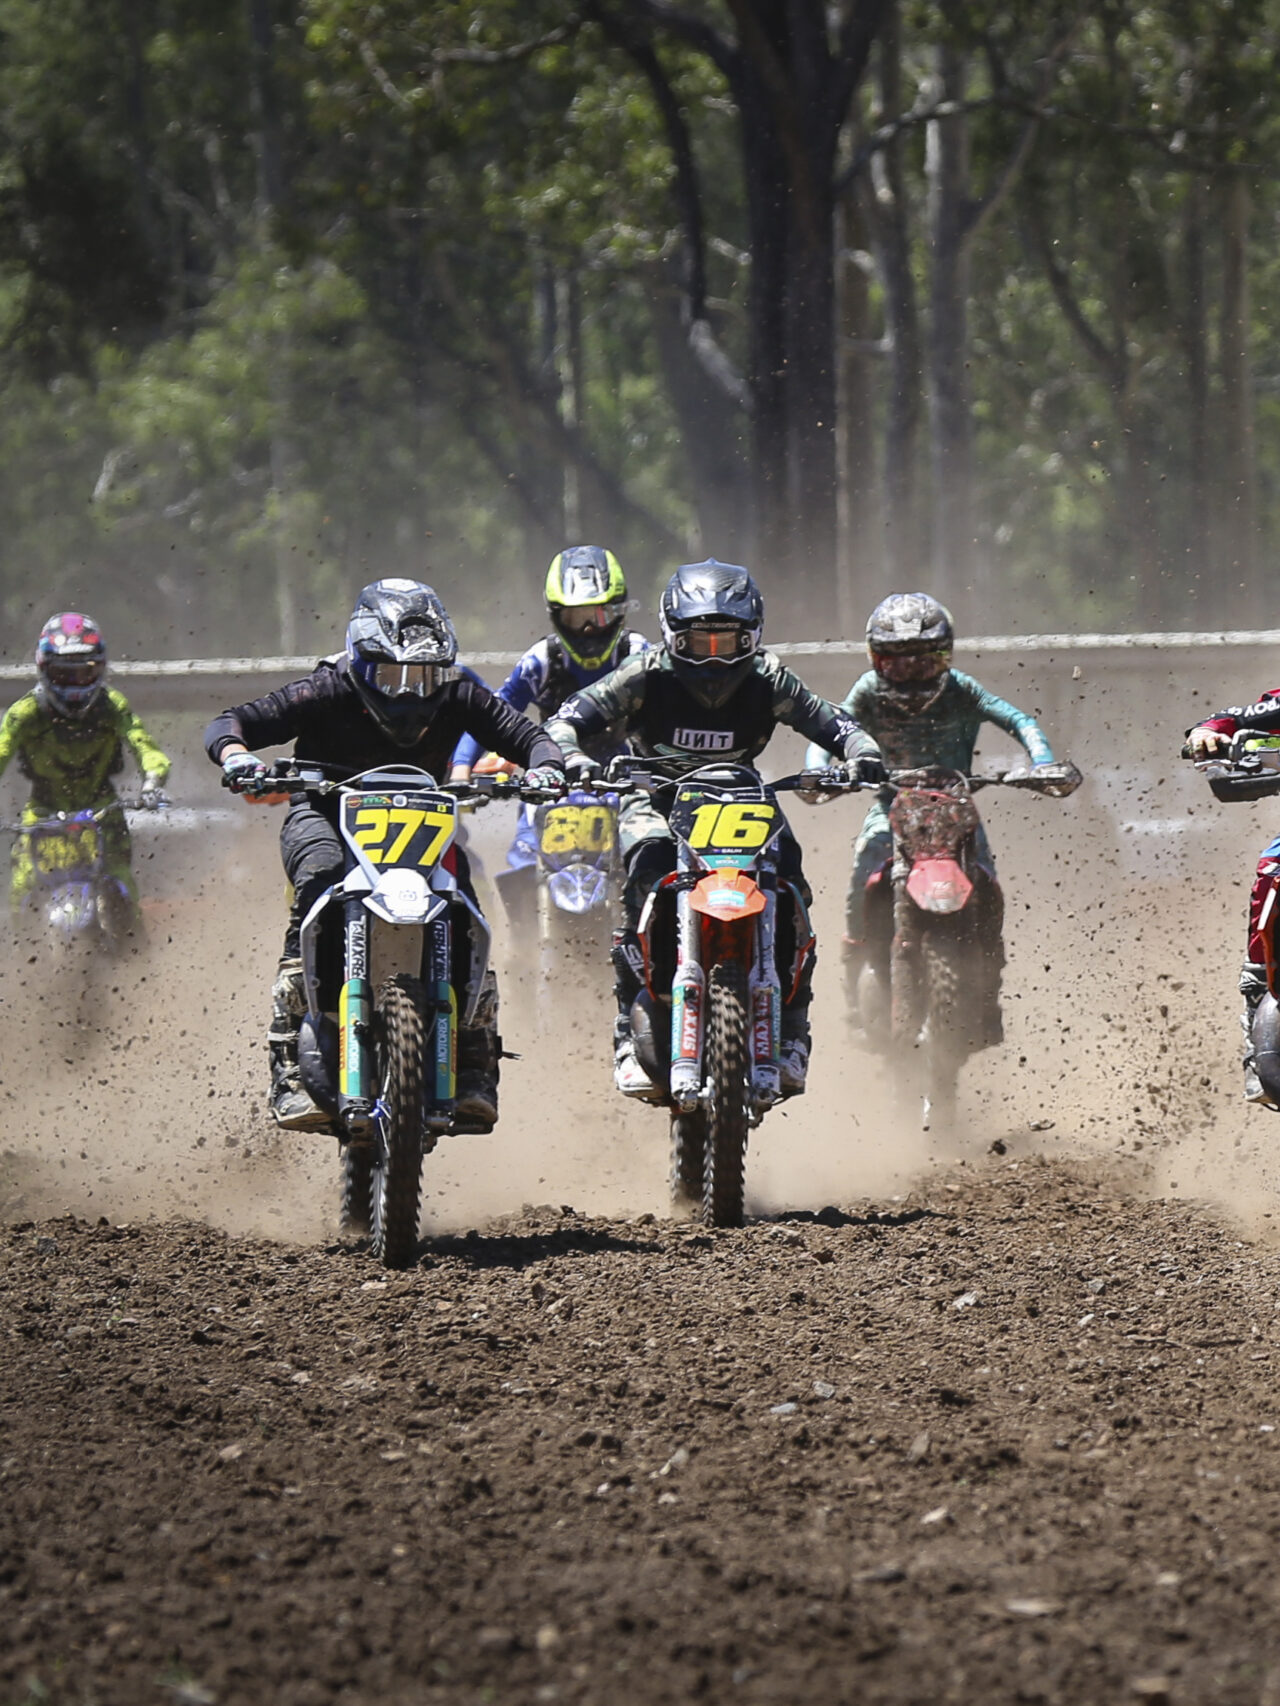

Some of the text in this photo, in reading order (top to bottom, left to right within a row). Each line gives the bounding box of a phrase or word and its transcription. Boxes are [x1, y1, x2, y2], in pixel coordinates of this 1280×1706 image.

[677, 728, 729, 748] UNIT
[353, 808, 455, 867] 277
[541, 806, 613, 854] 80
[688, 803, 775, 849] 16
[438, 1019, 448, 1063] MOTOREX
[683, 993, 698, 1051] AXXIS
